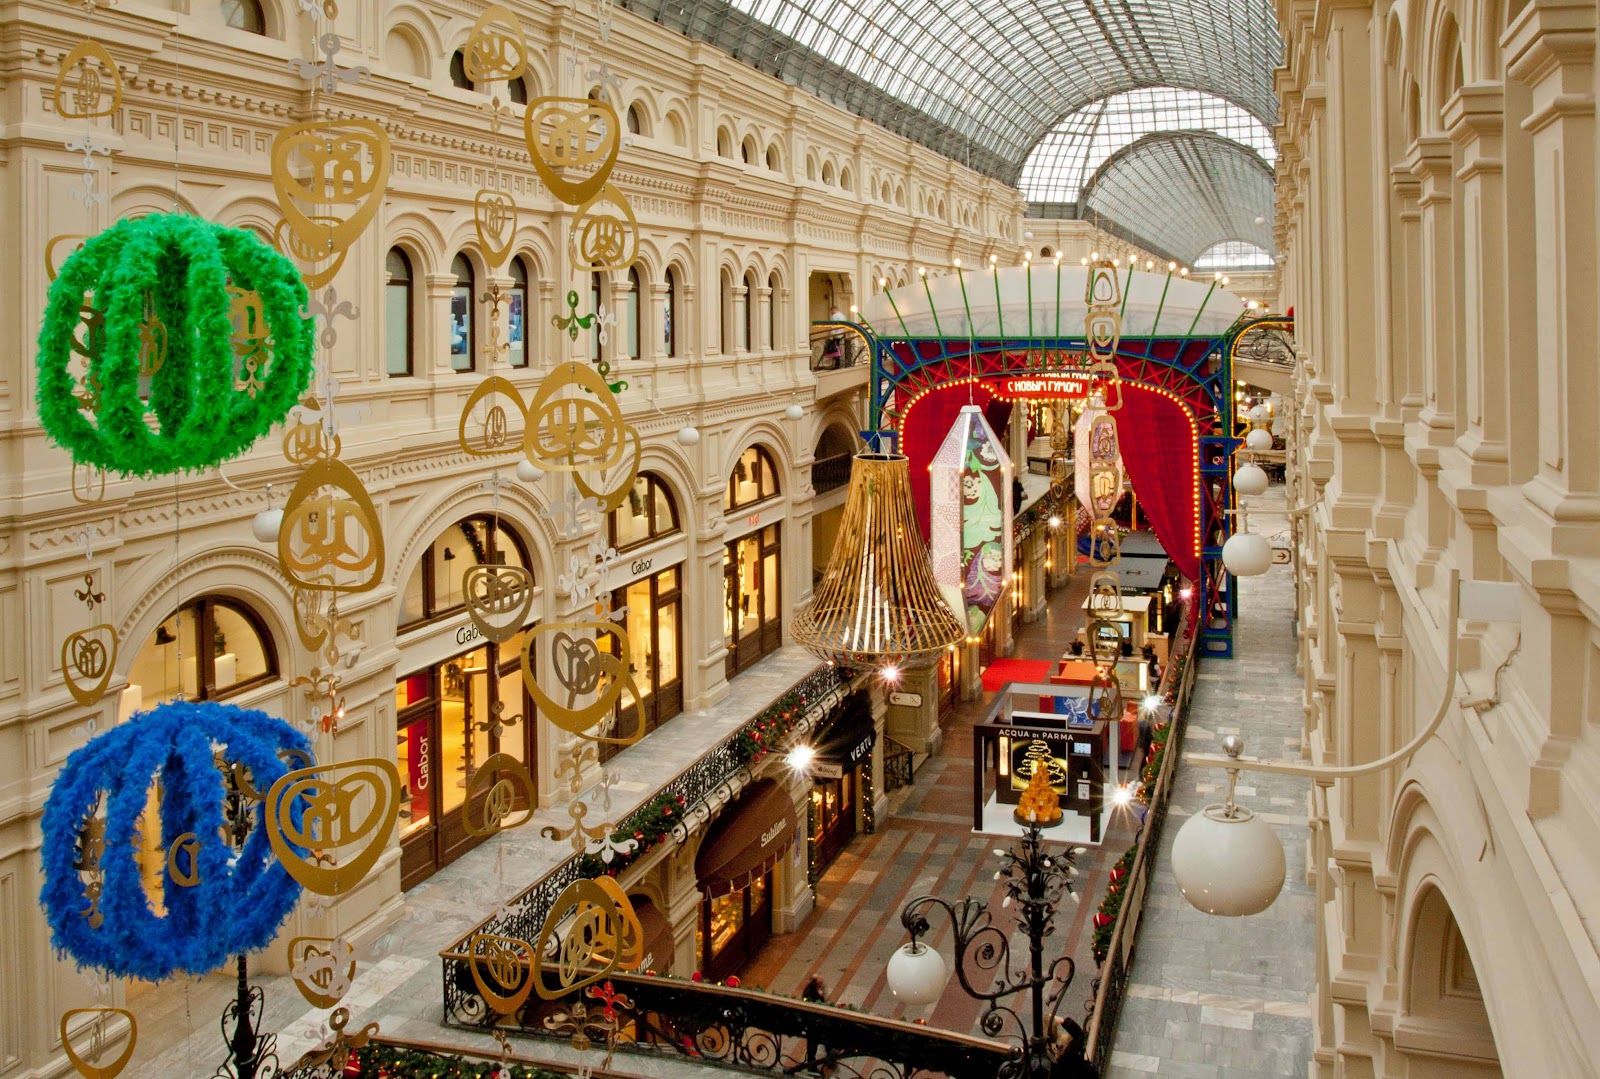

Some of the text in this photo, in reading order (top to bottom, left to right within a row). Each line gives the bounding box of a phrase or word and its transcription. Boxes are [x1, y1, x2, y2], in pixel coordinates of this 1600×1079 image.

[1007, 380, 1083, 394] С НОВЫМ ГУМОМ!
[631, 558, 653, 575] Gabor
[456, 622, 484, 645] Gab
[999, 729, 1029, 738] ACQUA
[1043, 732, 1074, 741] PARMA
[850, 734, 871, 761] VERTU
[417, 735, 429, 790] Gabor
